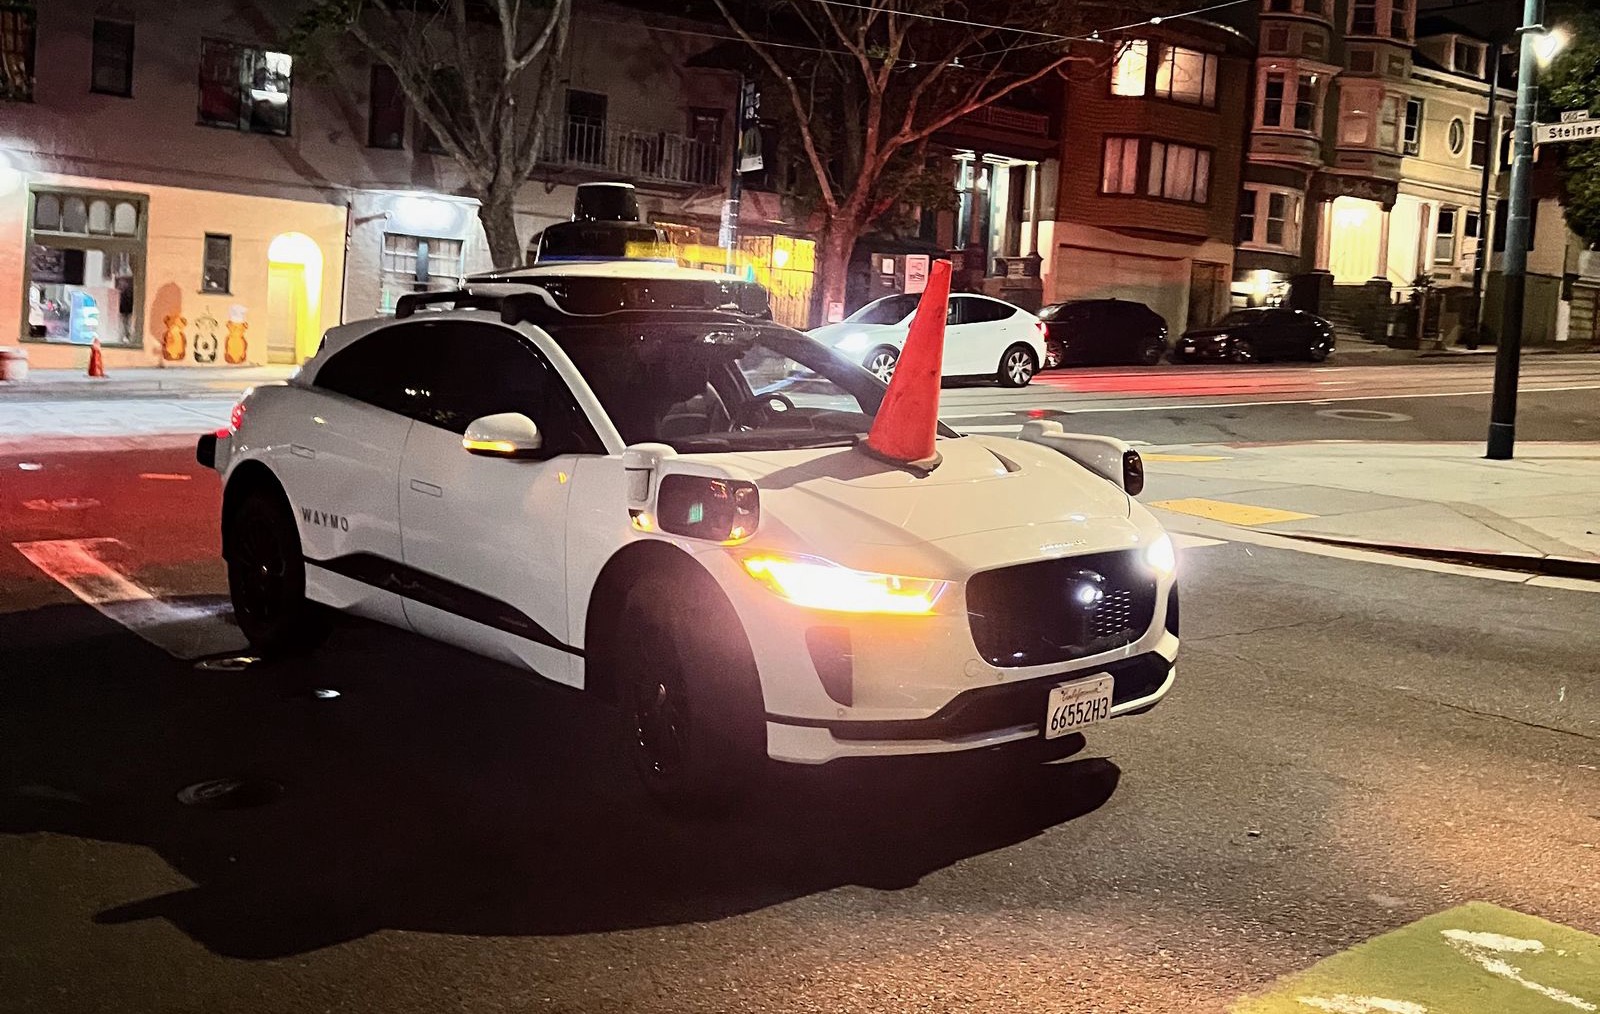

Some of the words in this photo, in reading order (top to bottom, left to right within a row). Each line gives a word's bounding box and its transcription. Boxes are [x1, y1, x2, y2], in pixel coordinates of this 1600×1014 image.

[1549, 125, 1600, 139] Steiner
[301, 506, 349, 532] WAYMO
[1051, 697, 1109, 731] 66552H3
